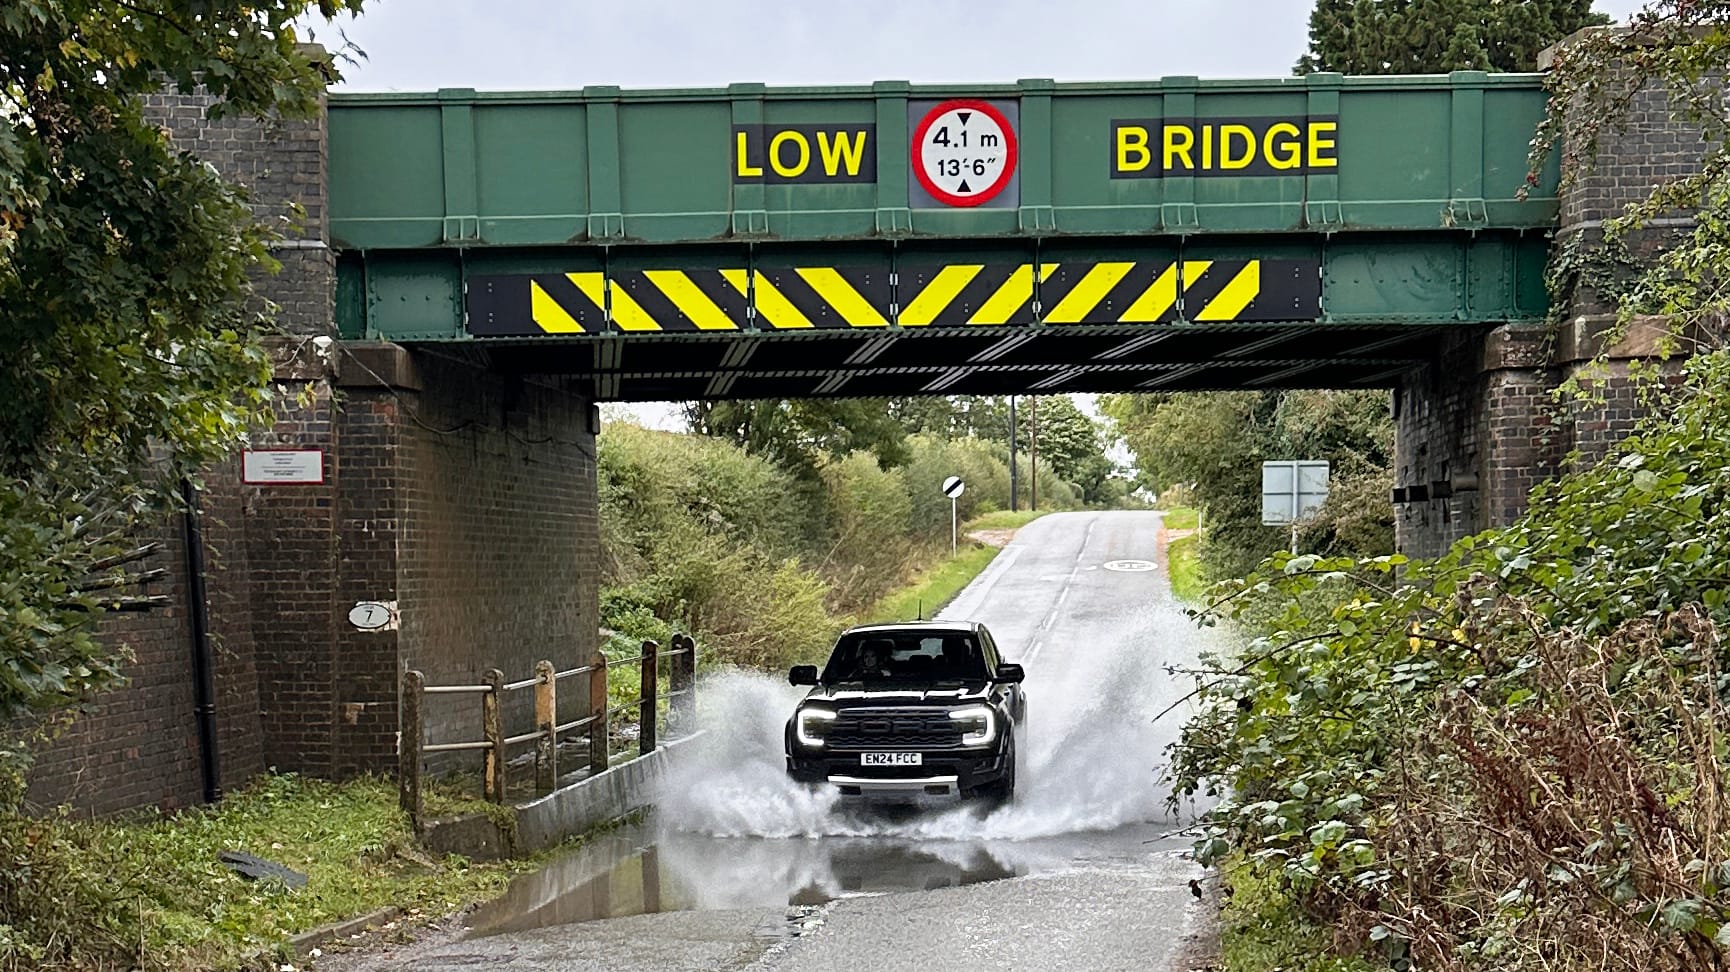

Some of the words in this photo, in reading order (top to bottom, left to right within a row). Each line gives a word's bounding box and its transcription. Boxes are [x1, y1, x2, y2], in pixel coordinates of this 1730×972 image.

[932, 126, 968, 148] 4.1
[980, 134, 998, 148] m
[736, 130, 867, 178] LOW
[1116, 122, 1338, 172] BRIDGE
[364, 609, 374, 622] 7
[865, 753, 893, 764] EN24
[896, 753, 917, 764] FCC
